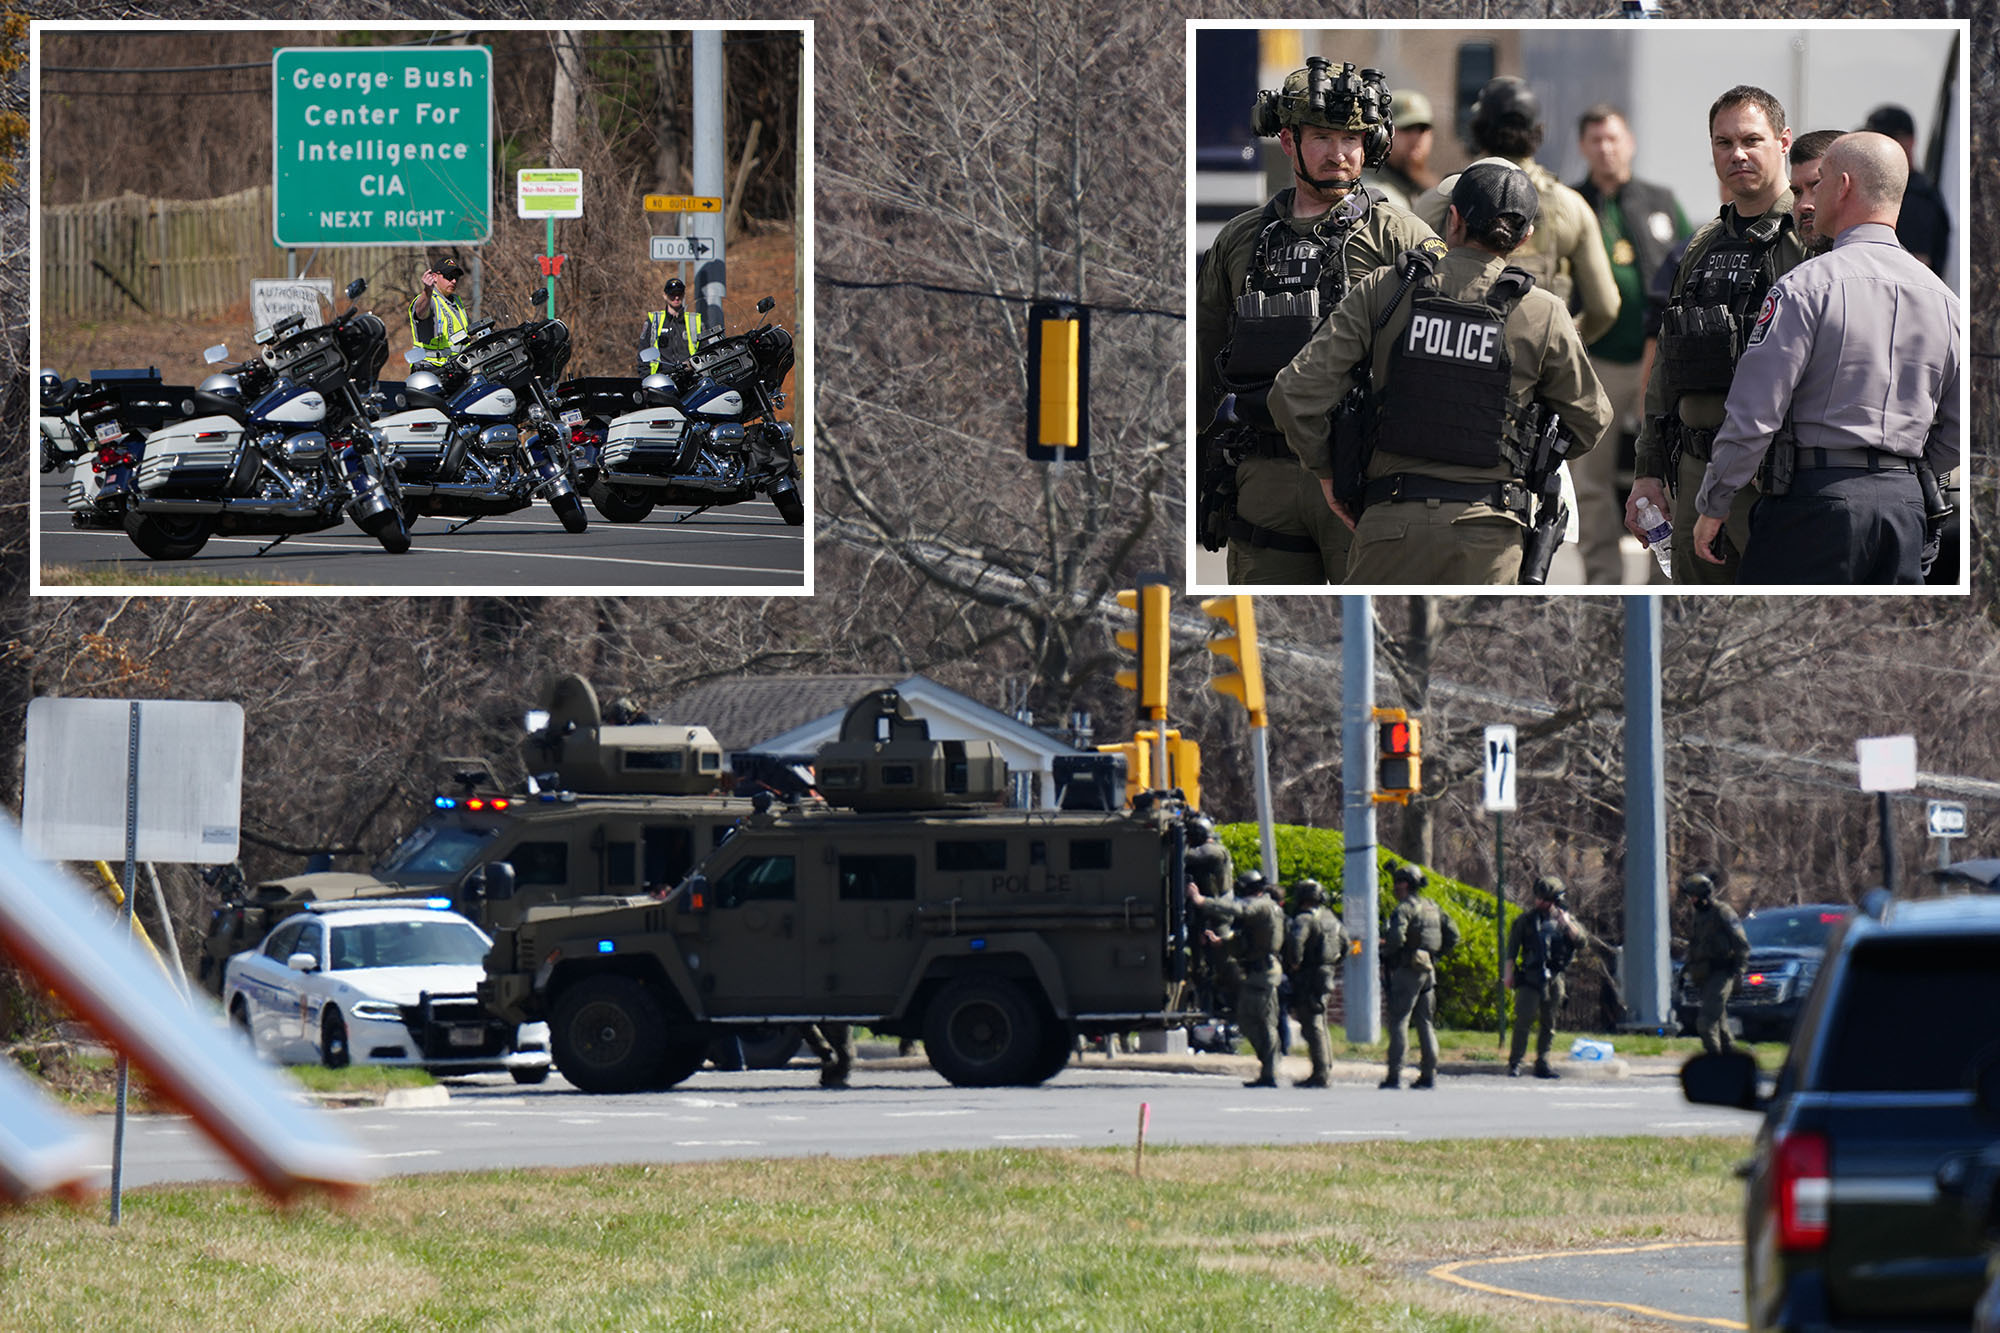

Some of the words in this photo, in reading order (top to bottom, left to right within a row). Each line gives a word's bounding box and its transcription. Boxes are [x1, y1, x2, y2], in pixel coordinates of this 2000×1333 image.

[293, 68, 389, 94] George
[404, 67, 473, 88] Bush
[304, 104, 400, 126] Center
[416, 103, 460, 124] For
[298, 139, 468, 167] Intelligence
[360, 174, 406, 196] CIA
[320, 211, 374, 228] NEXT
[384, 210, 445, 227] RIGHT
[1708, 254, 1750, 270] POLICE
[1408, 315, 1498, 363] POLICE
[992, 875, 1072, 894] POLCE
